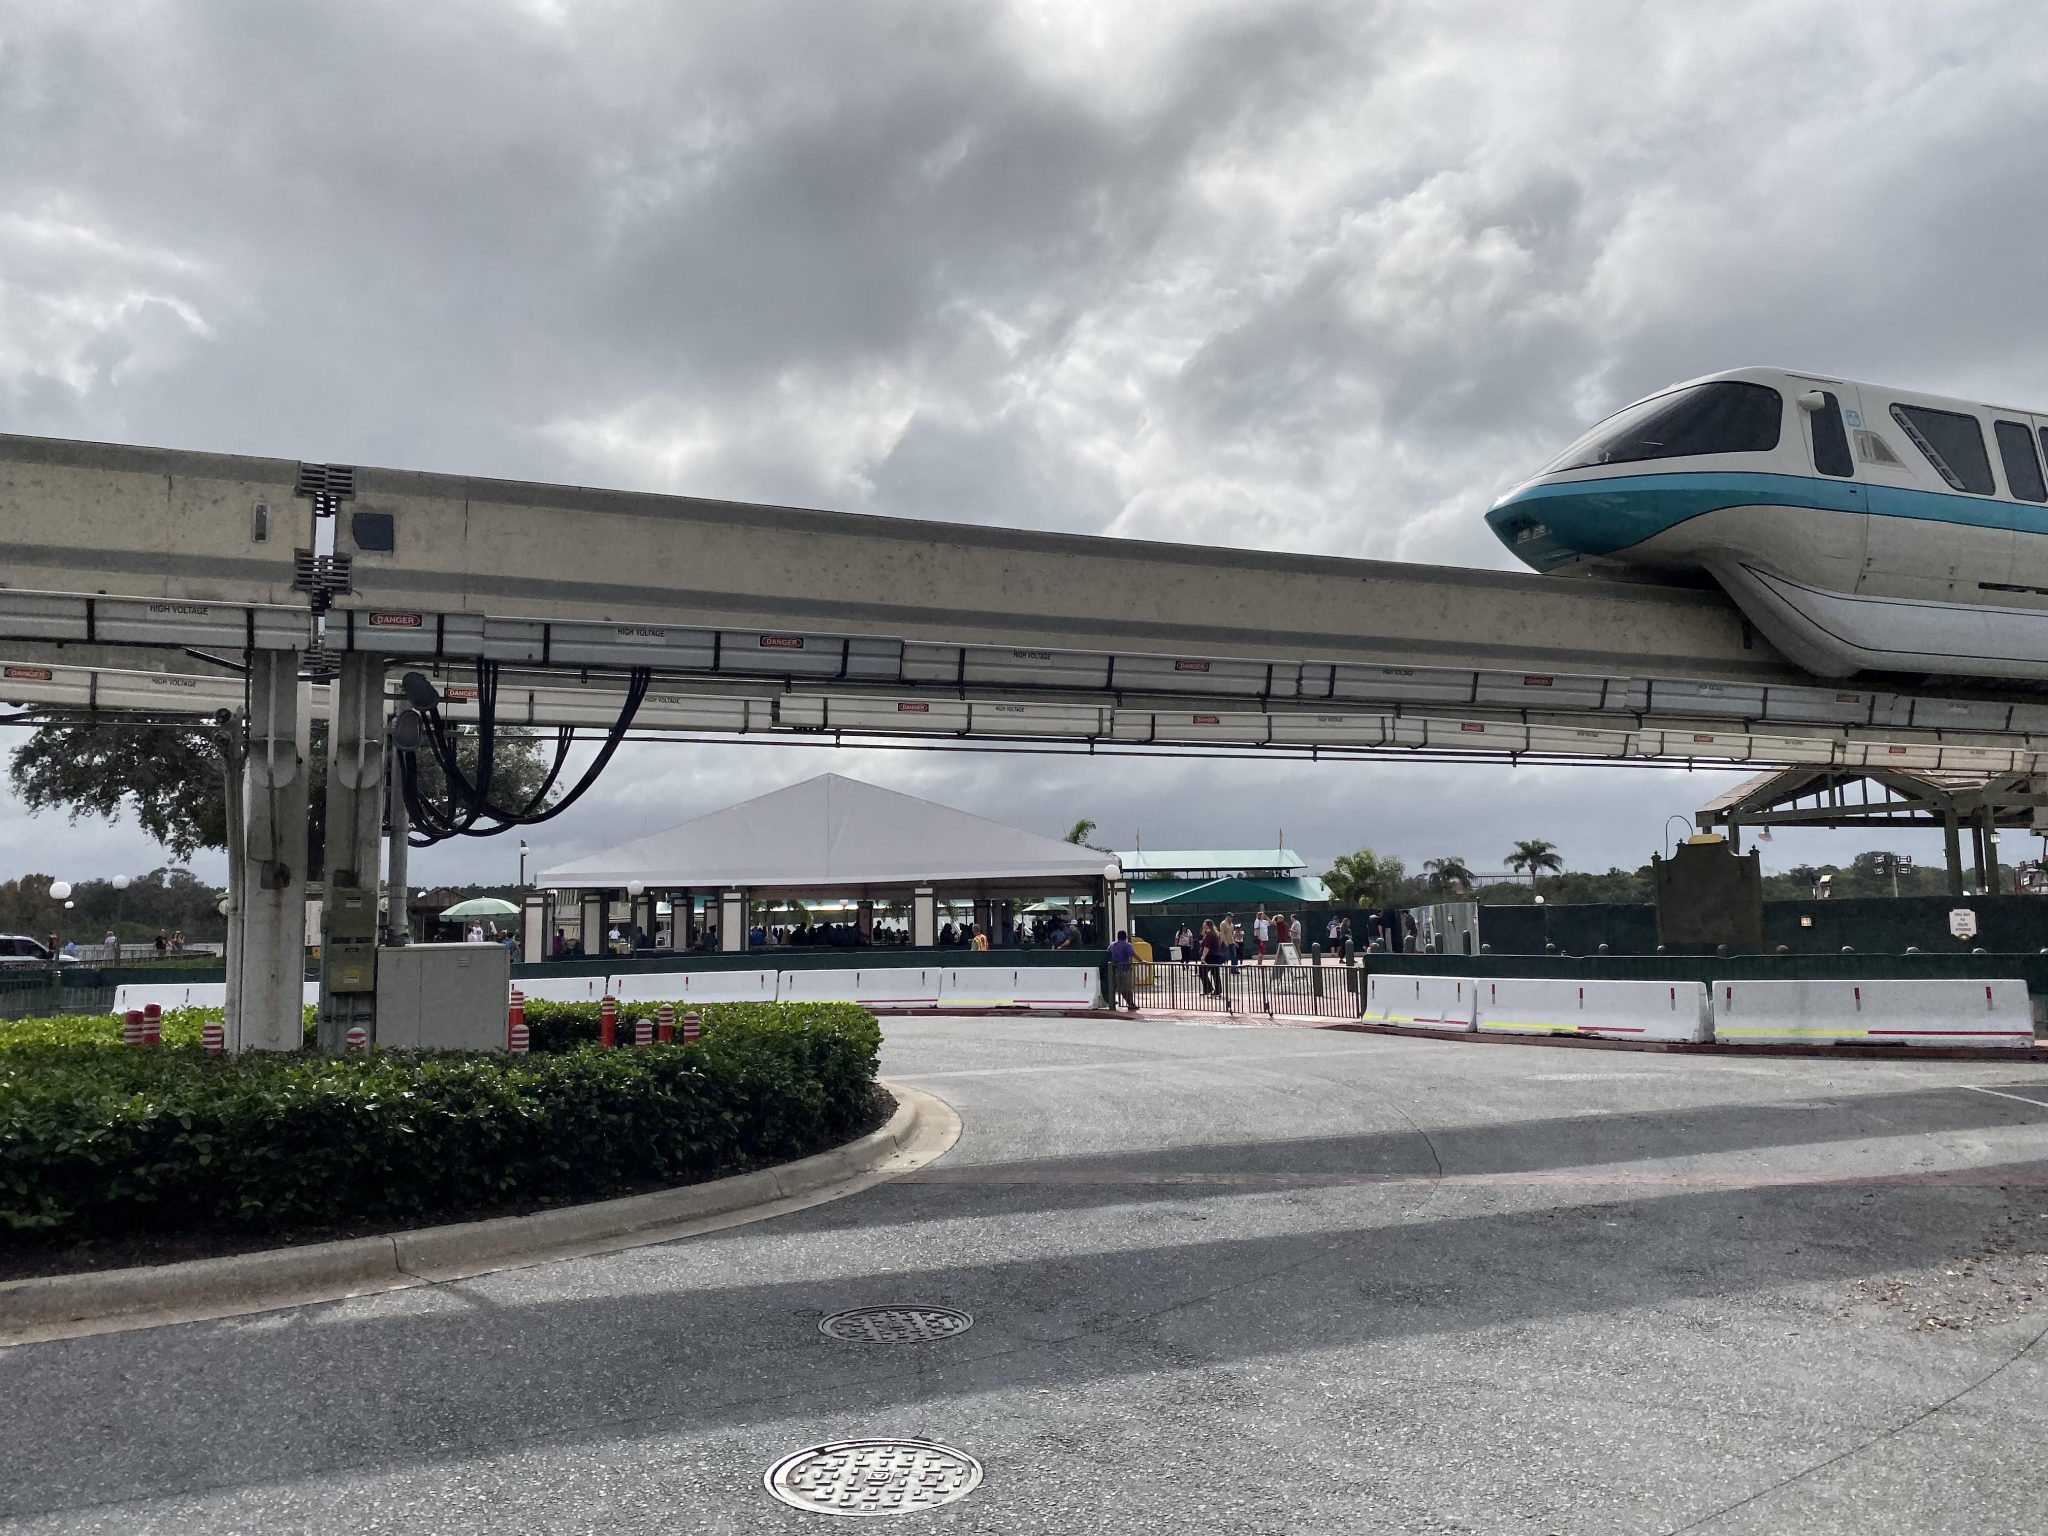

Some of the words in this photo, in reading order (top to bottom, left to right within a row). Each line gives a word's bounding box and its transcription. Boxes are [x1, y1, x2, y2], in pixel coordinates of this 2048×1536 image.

[150, 603, 170, 613] HIGH
[172, 604, 209, 616] VOLTAGE
[377, 615, 415, 625] DANGER
[617, 627, 634, 636] HIGH
[636, 628, 665, 638] VOLTAGE
[766, 638, 798, 647] DANGER
[1013, 650, 1027, 659] HIGH
[1027, 651, 1051, 660] VOLTAGE
[11, 669, 49, 679] DANGER
[152, 676, 168, 686] HIGH
[169, 678, 197, 688] VOLTAGE
[449, 689, 478, 698] DANGER
[644, 696, 657, 704] HIGH
[658, 696, 680, 705] VOLTAGE
